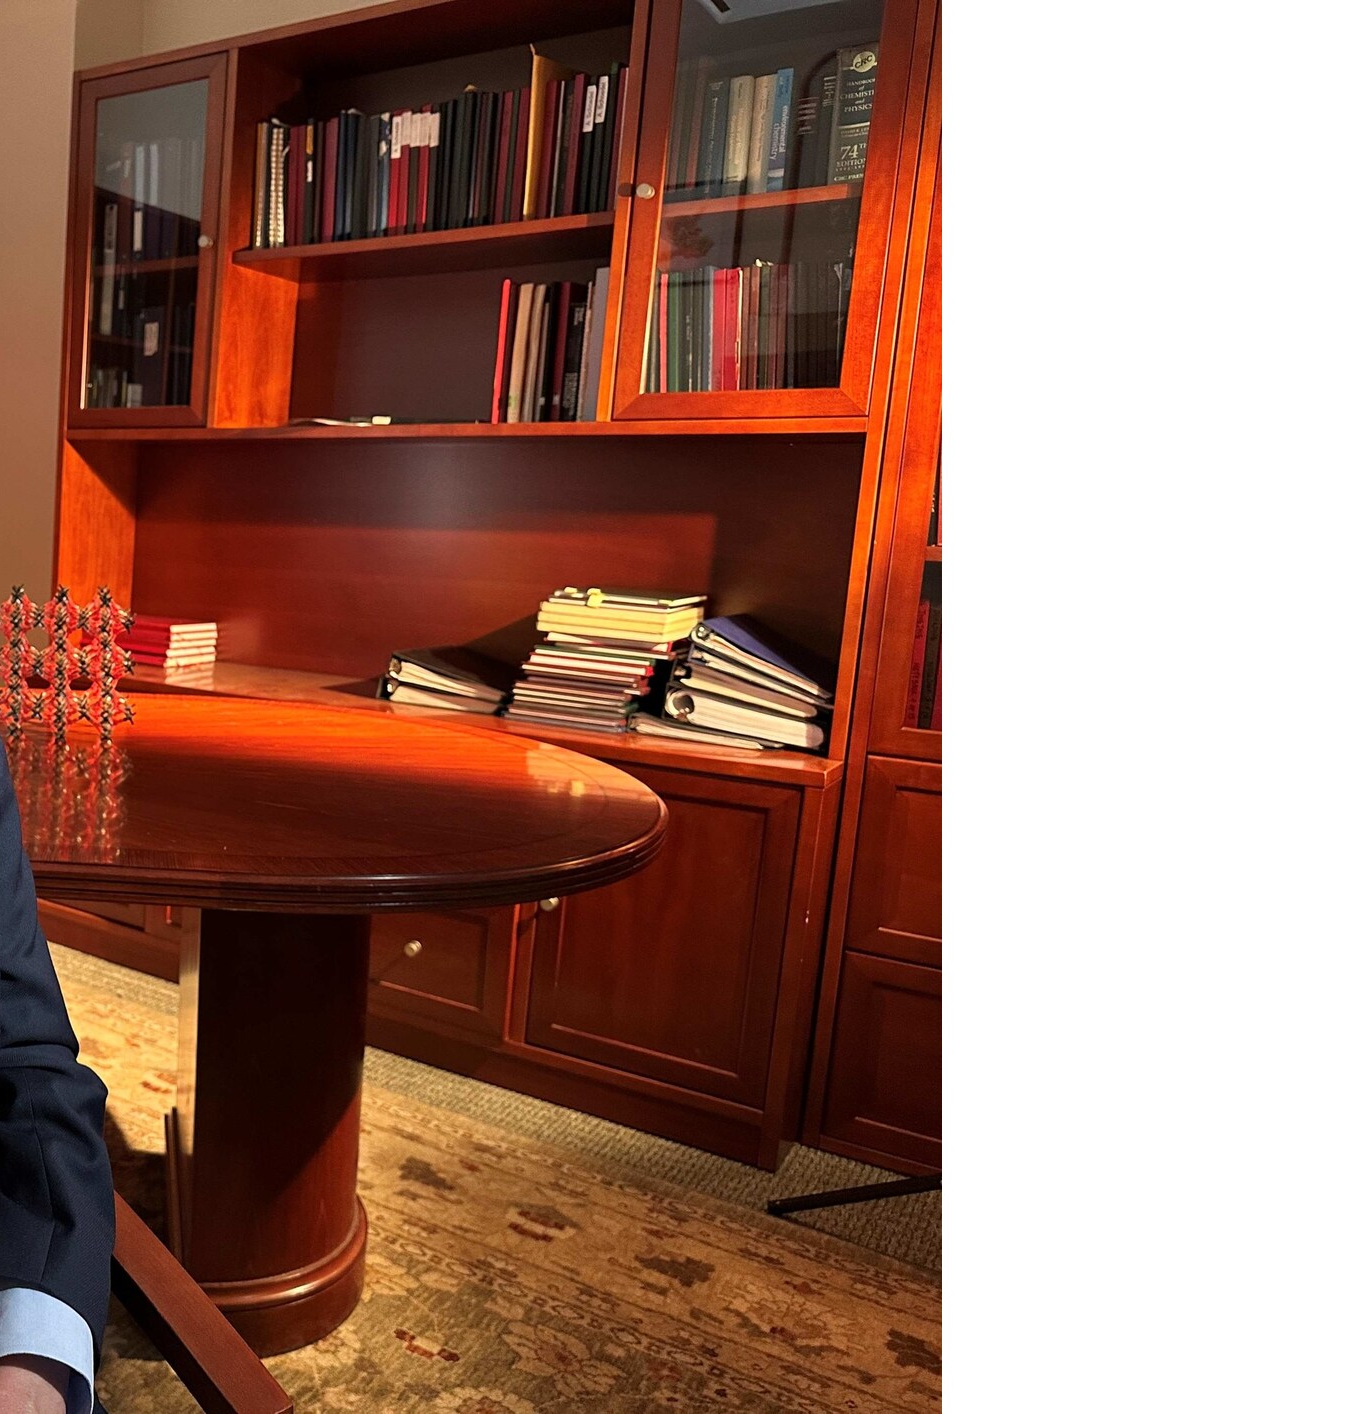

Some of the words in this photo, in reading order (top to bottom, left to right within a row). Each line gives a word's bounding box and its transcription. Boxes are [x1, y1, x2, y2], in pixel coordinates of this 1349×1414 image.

[854, 54, 873, 69] CRC
[844, 103, 873, 112] PHYSICS
[770, 123, 780, 161] chemistry
[779, 105, 789, 153] environmental
